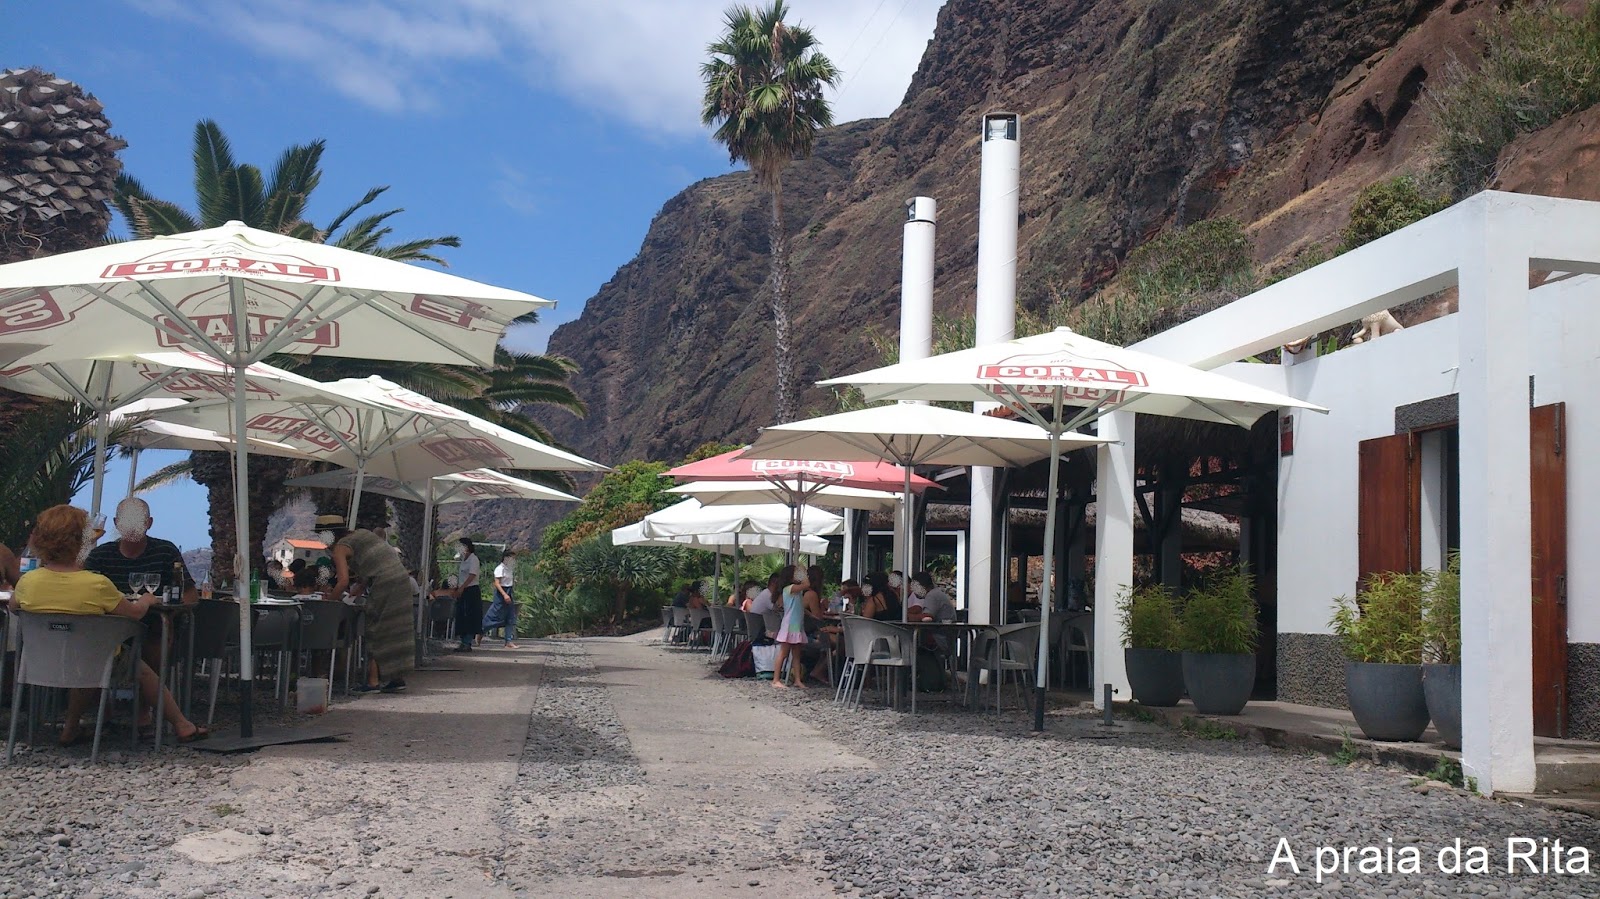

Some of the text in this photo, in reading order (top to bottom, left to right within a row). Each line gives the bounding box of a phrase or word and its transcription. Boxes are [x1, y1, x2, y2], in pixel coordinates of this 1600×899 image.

[133, 257, 311, 275] CORAL
[999, 366, 1129, 383] CORAL
[766, 460, 843, 471] CORAL
